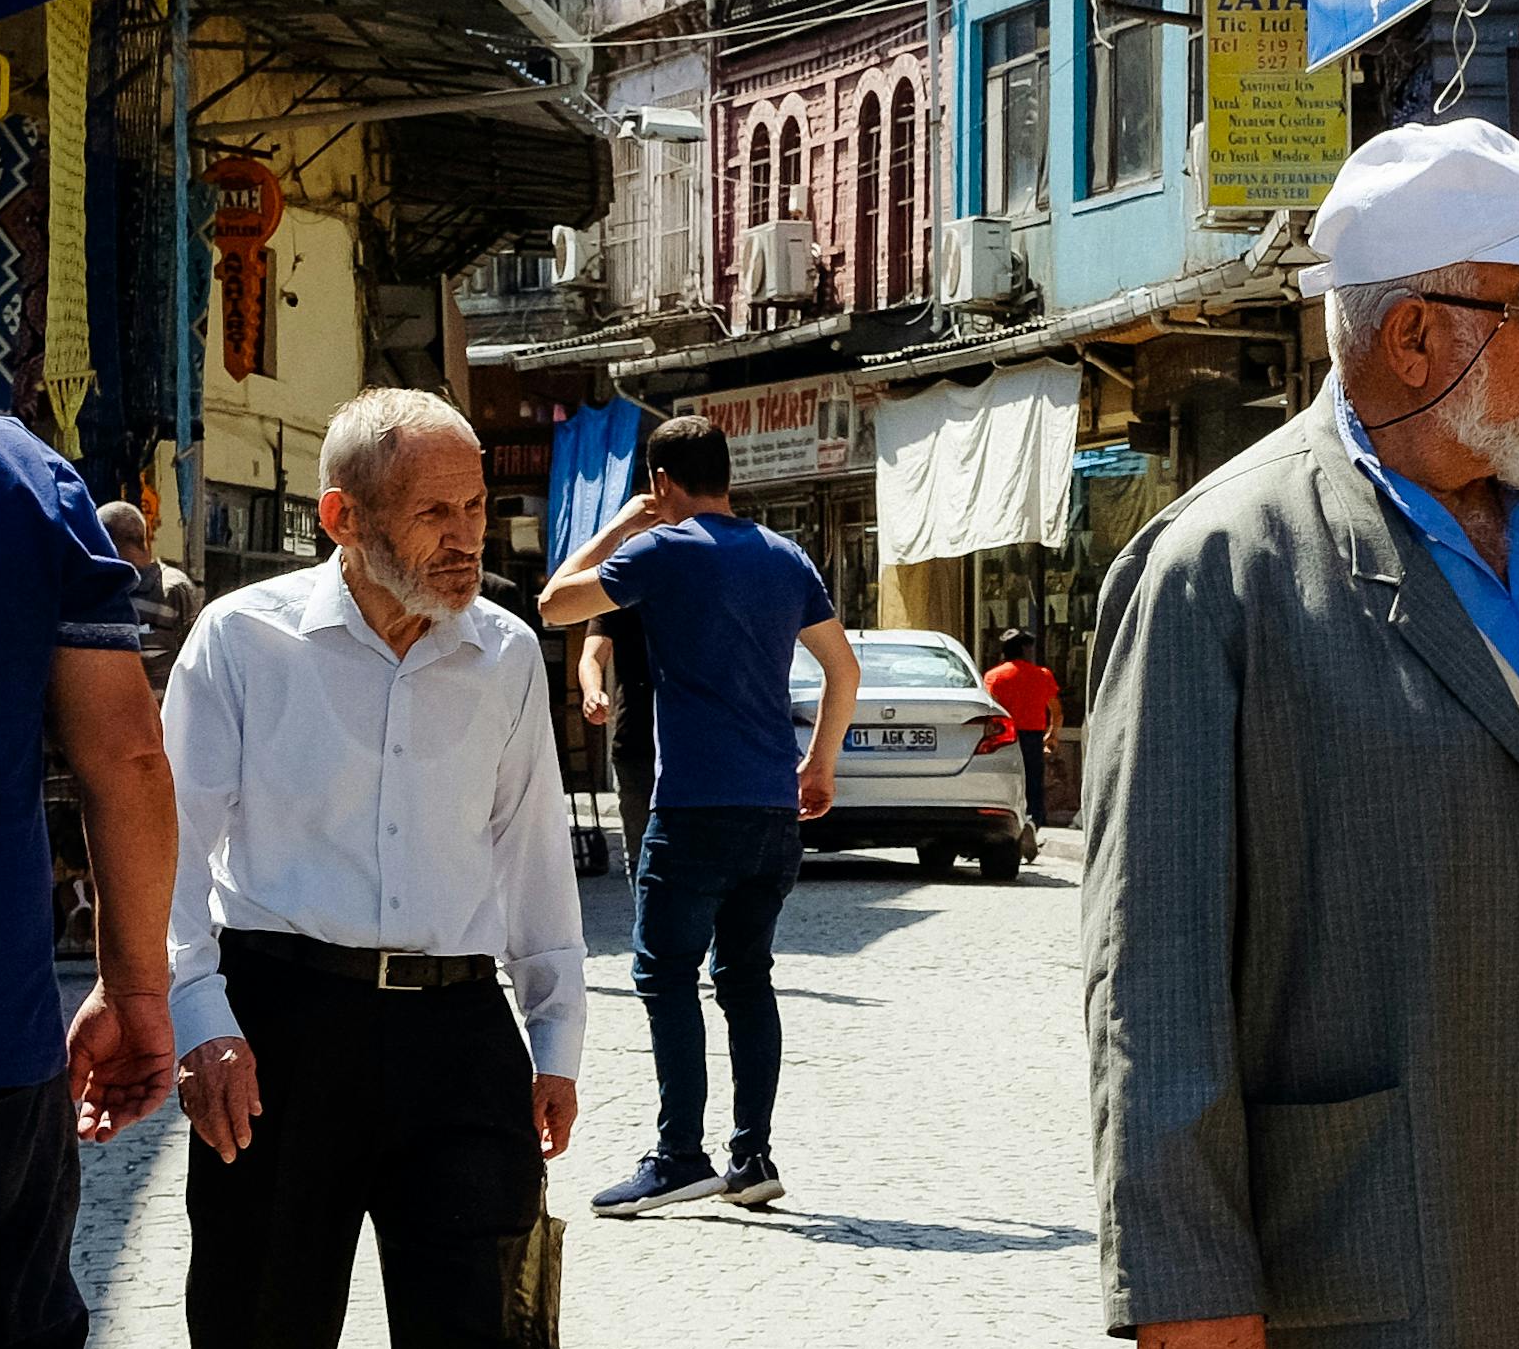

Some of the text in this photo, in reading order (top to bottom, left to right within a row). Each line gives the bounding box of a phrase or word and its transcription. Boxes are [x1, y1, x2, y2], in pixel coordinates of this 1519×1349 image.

[1216, 16, 1298, 32] Tic. Ltd.
[1210, 37, 1238, 53] Tel
[1257, 39, 1288, 52] 519
[1257, 55, 1288, 69] 527
[854, 730, 868, 745] 01
[881, 730, 905, 745] AGK
